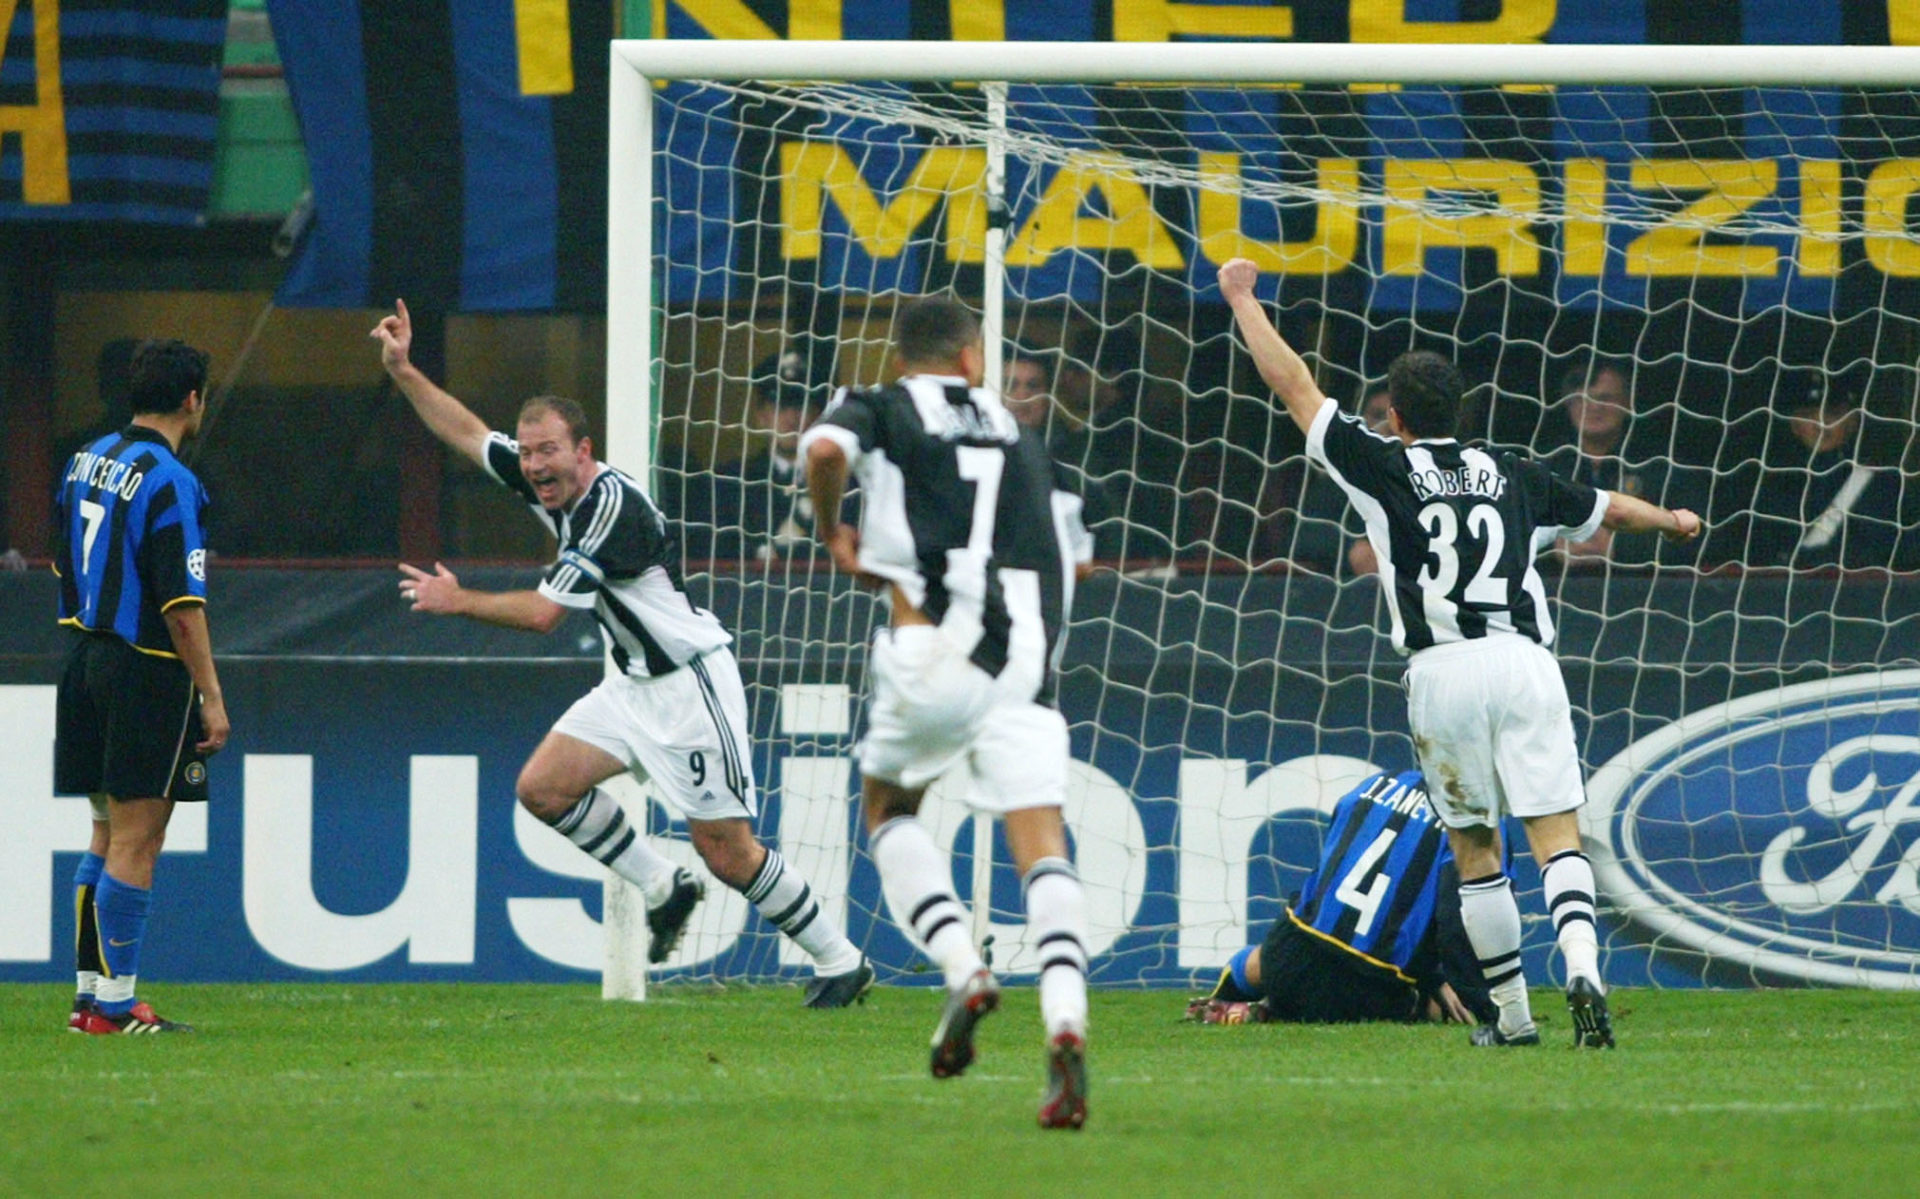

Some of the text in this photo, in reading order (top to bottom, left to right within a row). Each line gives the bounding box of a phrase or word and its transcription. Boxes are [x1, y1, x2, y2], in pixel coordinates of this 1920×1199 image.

[955, 444, 1006, 557] 7
[1409, 467, 1507, 501] ROBERT
[79, 499, 105, 575] 7
[1416, 502, 1508, 605] 32
[689, 751, 706, 787] 9
[1335, 828, 1397, 936] 4
